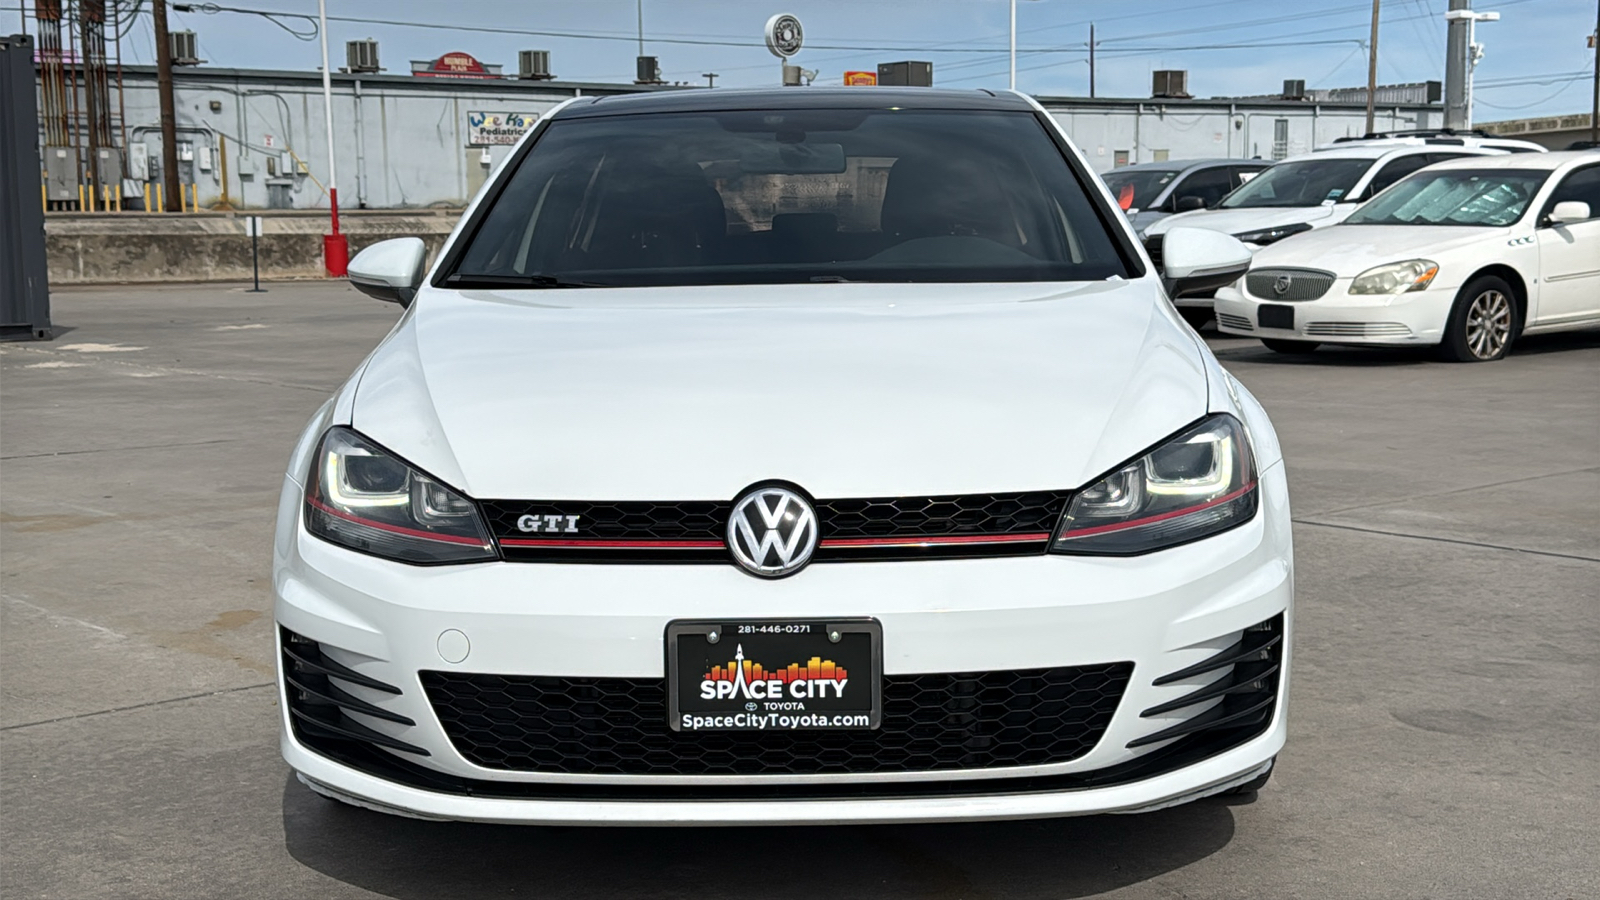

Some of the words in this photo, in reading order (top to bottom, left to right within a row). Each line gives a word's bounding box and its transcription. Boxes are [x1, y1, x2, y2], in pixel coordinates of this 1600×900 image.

[470, 112, 502, 127] Wee
[517, 514, 580, 533] GTI
[738, 625, 811, 633] 281-446-0271
[700, 679, 783, 699] SPACE
[789, 679, 848, 699] CITY
[763, 702, 805, 711] TOYOTA
[682, 713, 869, 730] SpaceCityToyota.com
